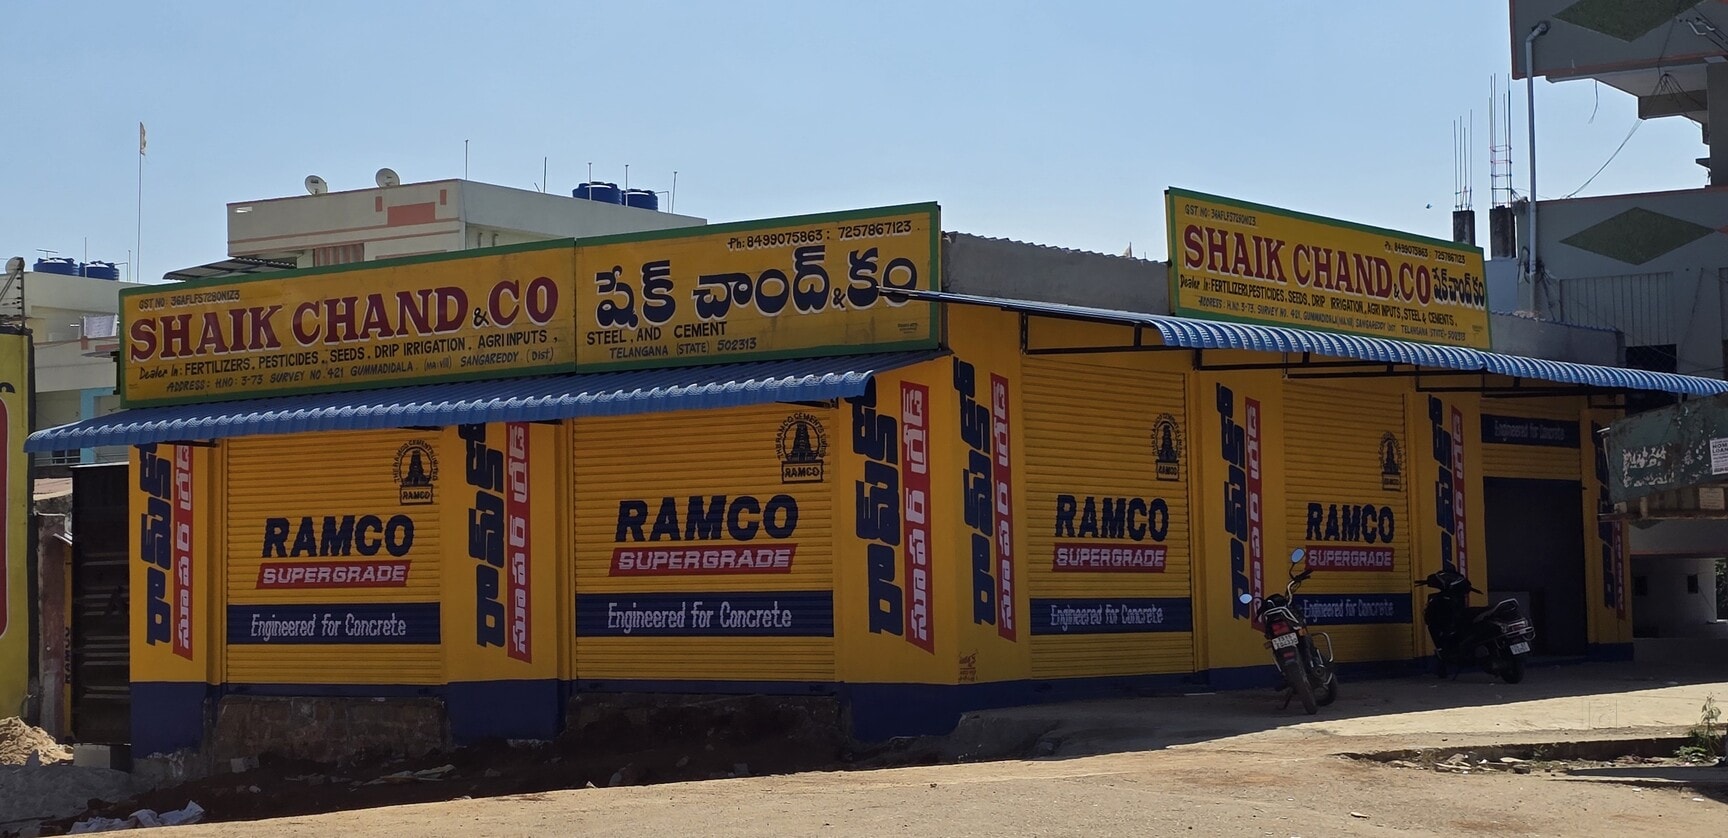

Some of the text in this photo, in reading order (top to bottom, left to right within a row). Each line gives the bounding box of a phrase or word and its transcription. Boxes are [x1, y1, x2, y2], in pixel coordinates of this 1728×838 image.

[1185, 204, 1198, 216] GST
[1184, 224, 1431, 305] SHAIK CHAND & CO
[596, 260, 676, 328] షేక్
[692, 245, 830, 320] చాంద్
[832, 287, 847, 310] &
[1180, 274, 1200, 290] Dealer
[1312, 294, 1326, 307] DRIP
[1404, 308, 1421, 322] STEEL
[131, 276, 559, 362] SHAIK CHAND & CO
[139, 298, 154, 310] GST
[637, 327, 662, 342] AND
[673, 321, 727, 339] CEMENT
[139, 366, 168, 380] Dealer
[374, 343, 399, 359] DRIP
[610, 345, 669, 360] TELANGANA
[717, 337, 757, 352] 502313
[241, 375, 264, 386] 3-73
[270, 371, 306, 384] SURVEY
[784, 467, 820, 478] RAMCO
[402, 491, 431, 500] RAMCO
[615, 494, 799, 543] RAMCO
[1055, 494, 1169, 542] RAMCO
[1305, 502, 1395, 544] RAMCO
[262, 513, 415, 559] RAMCO
[617, 549, 792, 571] SUPERGRADE
[904, 487, 928, 642] సూపర్
[1056, 547, 1165, 568] SUPERGRADE
[1308, 550, 1392, 568] SUPERGRADE
[176, 520, 191, 651] సూపర్
[262, 563, 407, 585] SUPERGRADE
[509, 513, 526, 654] సూపర్
[608, 601, 792, 635] Engineered for Concrete
[1050, 604, 1164, 632] Engineered for Concrete
[1303, 598, 1394, 622] Engineered for Concrete
[251, 612, 407, 642] Engineered for Concrete
